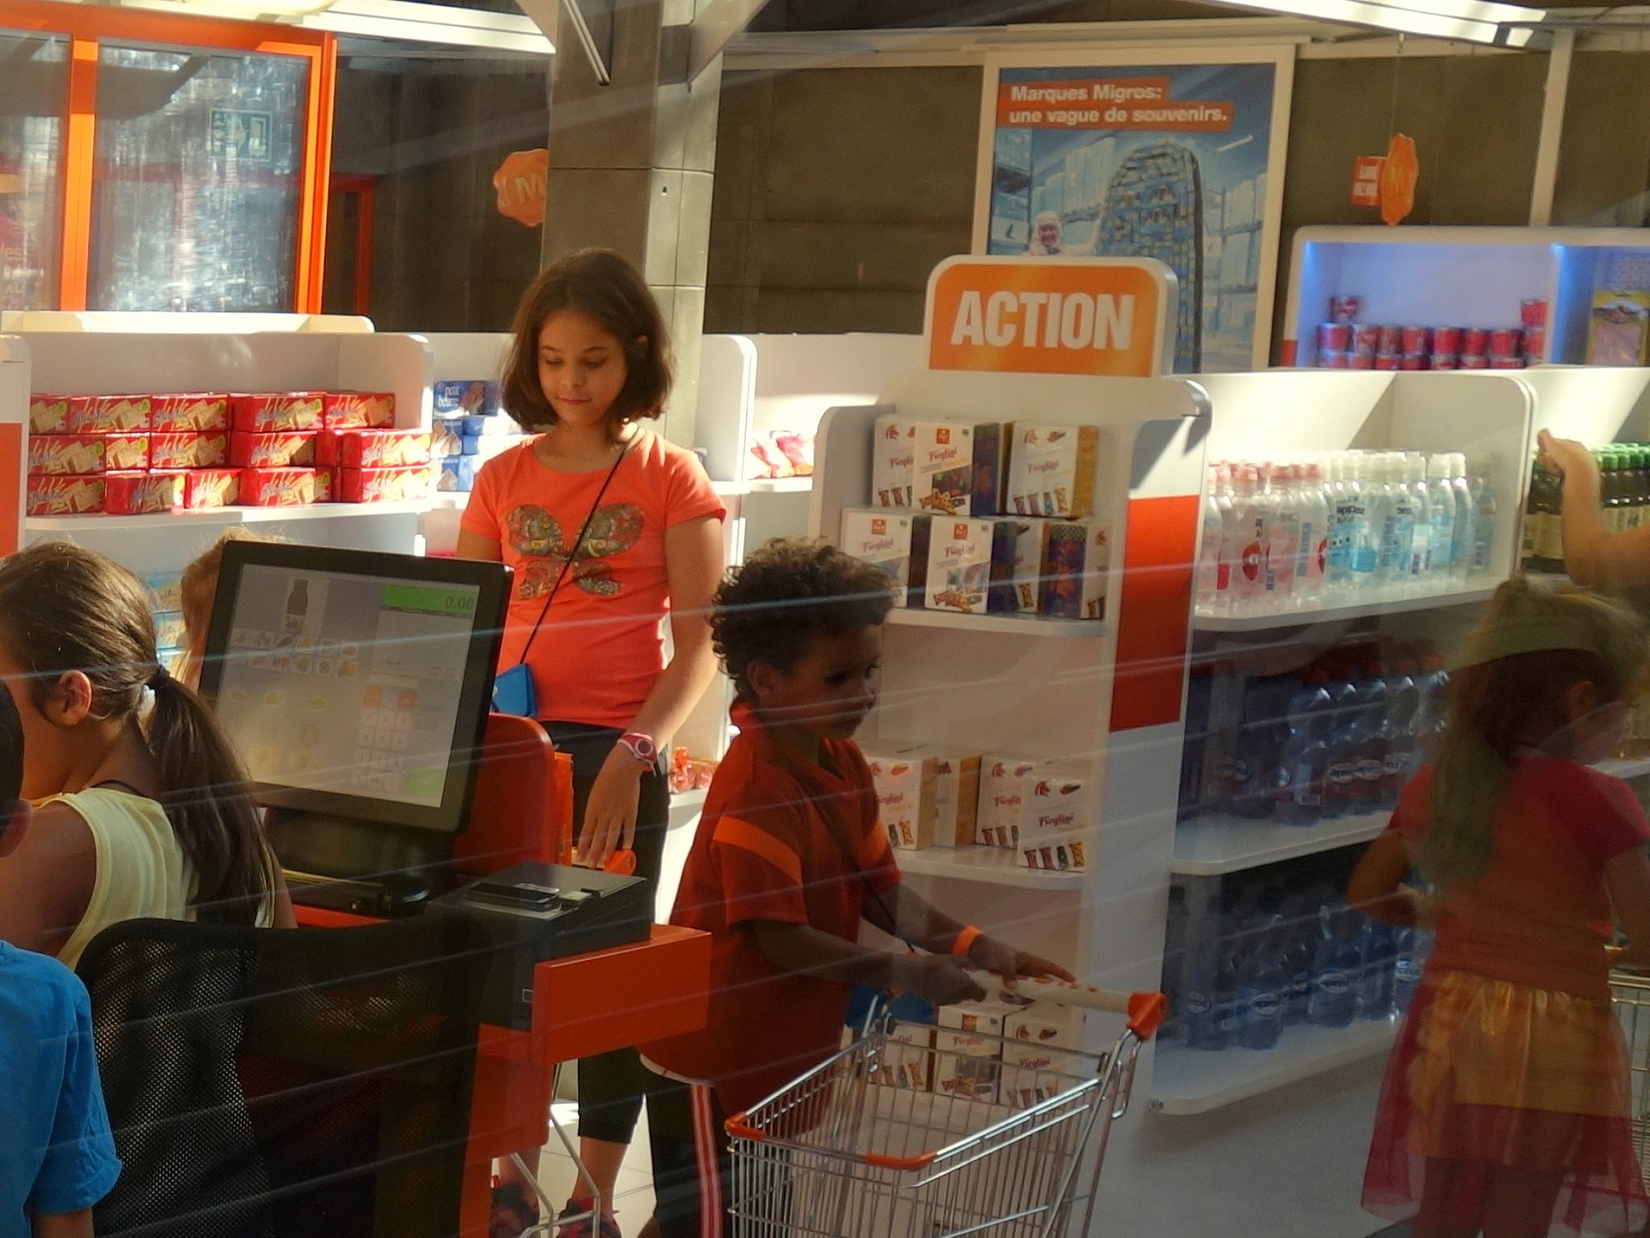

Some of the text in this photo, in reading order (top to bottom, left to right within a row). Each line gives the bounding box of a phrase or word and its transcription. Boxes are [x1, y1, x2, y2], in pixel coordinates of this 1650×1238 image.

[1011, 83, 1164, 103] Marques Migros:
[1009, 105, 1228, 125] une vague de souvenirs.
[950, 289, 1136, 350] ACTION
